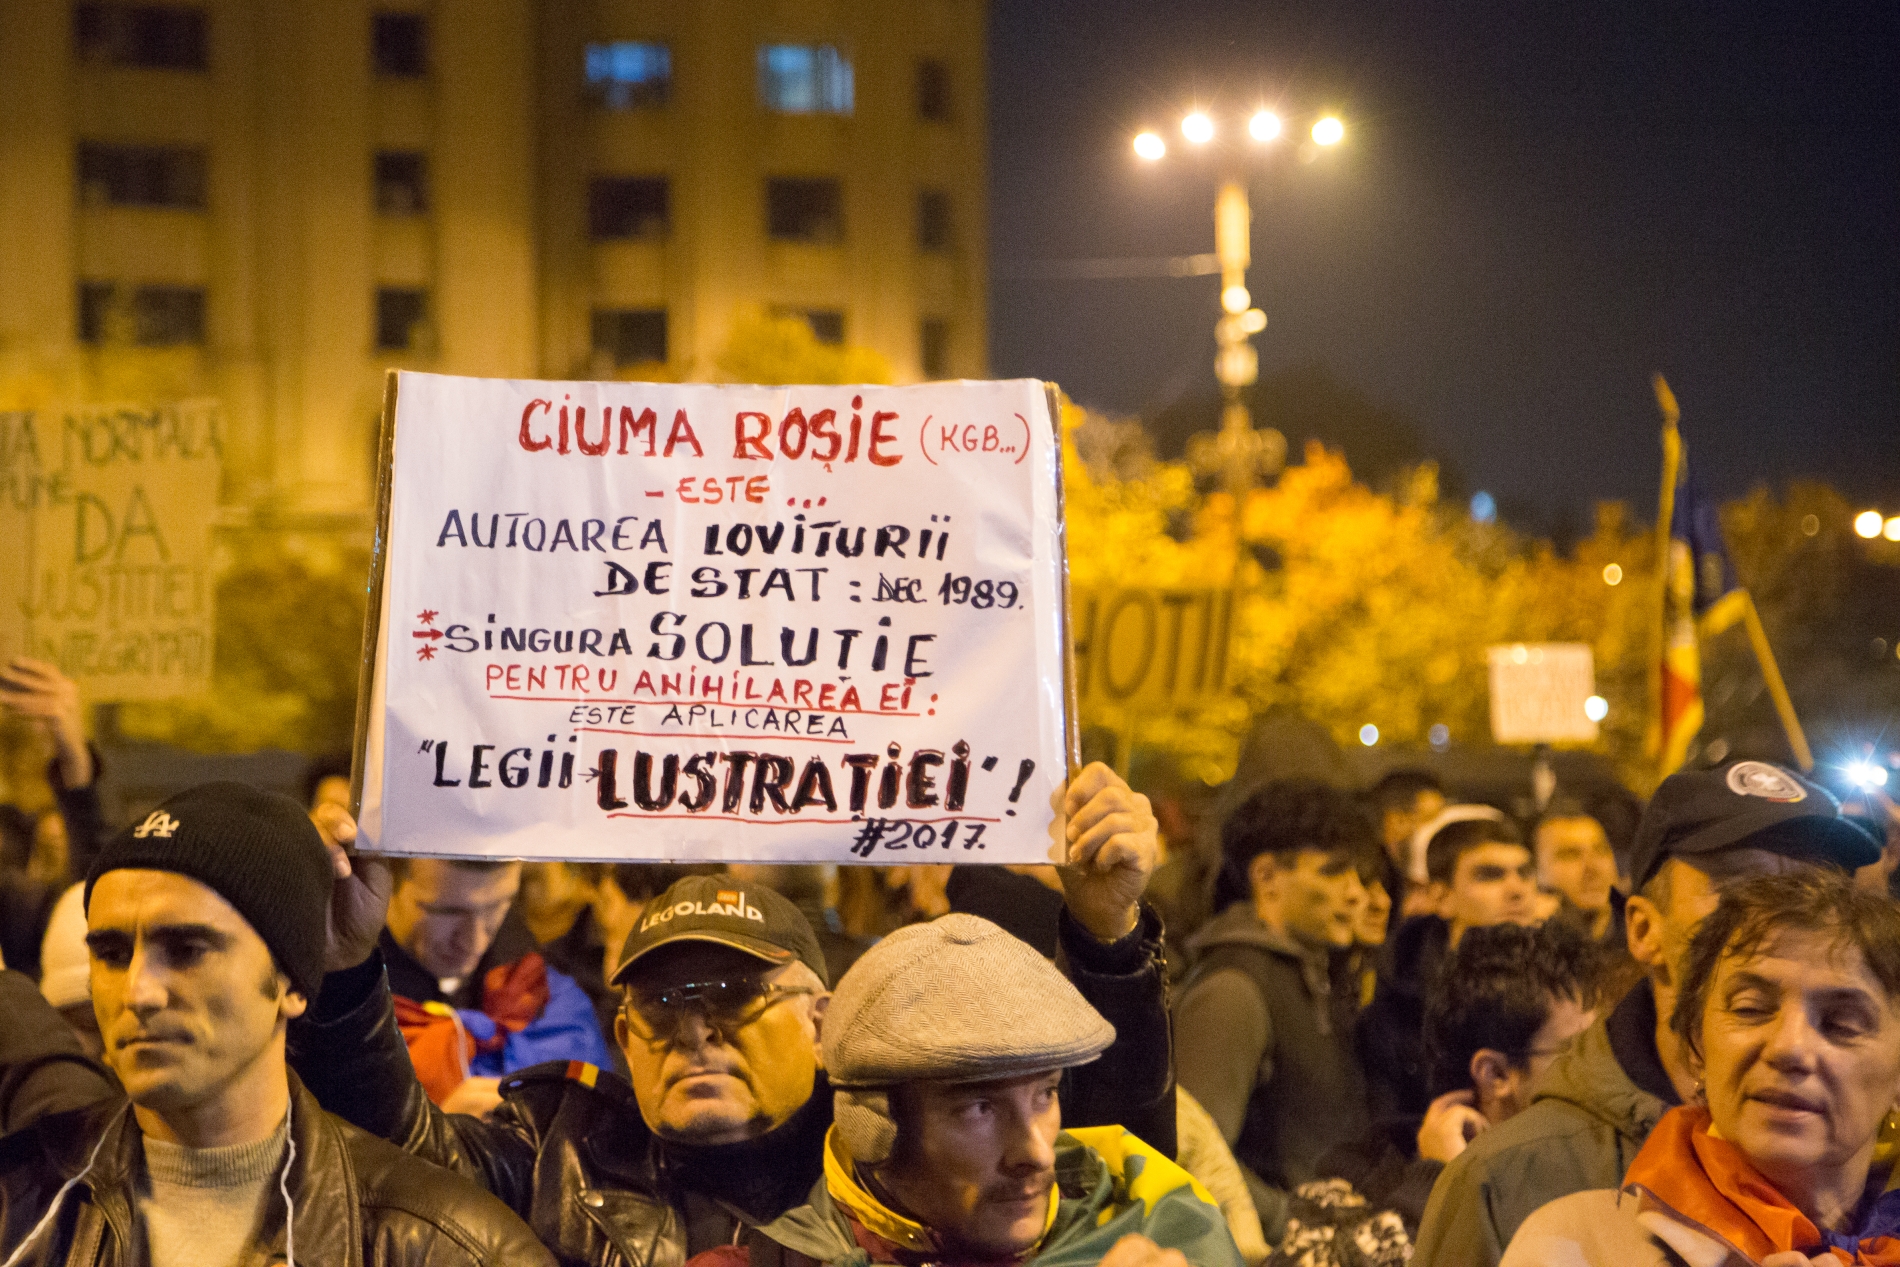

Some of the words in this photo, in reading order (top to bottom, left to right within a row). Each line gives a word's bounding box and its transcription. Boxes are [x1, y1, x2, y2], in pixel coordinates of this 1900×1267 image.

[675, 474, 771, 505] ESTE
[73, 486, 171, 564] DA
[435, 508, 669, 554] AUTOAREA
[592, 560, 674, 598] DE
[485, 663, 618, 694] PENTRU
[568, 704, 637, 726] ESTE
[660, 703, 849, 740] APLICAREA
[639, 890, 765, 934] LEGOLAND
